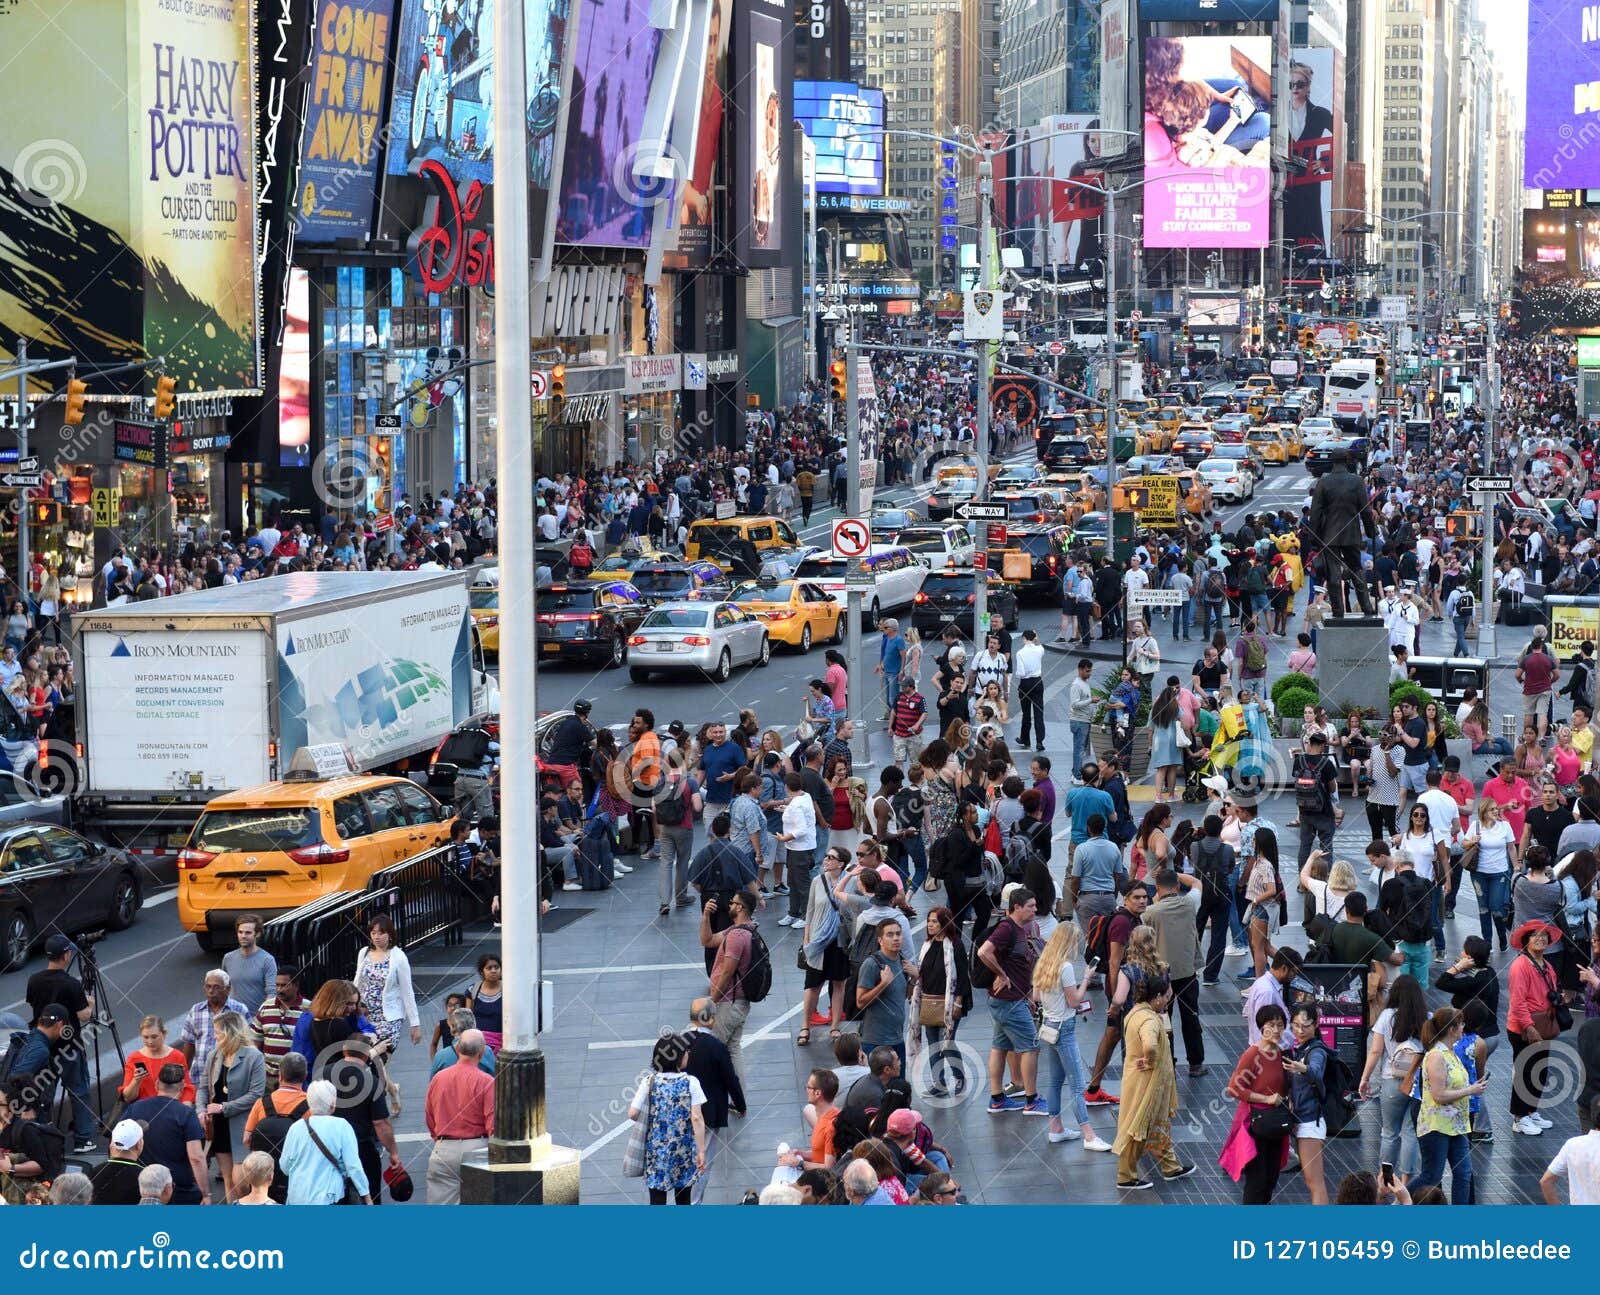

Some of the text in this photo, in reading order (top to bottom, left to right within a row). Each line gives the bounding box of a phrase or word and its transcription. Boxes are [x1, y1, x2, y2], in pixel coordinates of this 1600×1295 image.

[166, 0, 182, 12] BOLT
[185, 2, 193, 14] OF
[1582, 6, 1600, 42] N
[321, 3, 388, 62] COME
[153, 43, 239, 122] HARRY
[314, 54, 383, 115] FROM
[307, 109, 378, 165] AWAY
[149, 108, 248, 182] POTTER
[185, 182, 212, 196] AND THE
[1175, 193, 1238, 207] MILITARY
[161, 196, 237, 222] CURSED CHILD
[1175, 208, 1238, 221] FAMILIES
[1162, 221, 1251, 233] STAY CONNECTED
[172, 228, 227, 240] PARTS ONE AND TWO
[643, 360, 659, 377] POLO
[177, 395, 234, 420] LUGGAGE
[193, 437, 214, 450] SONY
[1142, 479, 1175, 488] REAL MEN
[1473, 480, 1507, 488] ONE WAY
[1151, 494, 1165, 502] STOP
[97, 489, 107, 521] ATM
[961, 506, 1001, 515] ONE WAY
[400, 604, 461, 629] INFORMATION MANAGED
[90, 622, 113, 630] 11684
[297, 629, 349, 654] IRON MOUNTAIN
[1554, 641, 1566, 650] The
[134, 644, 238, 657] IRON MOUNTAIN
[134, 674, 192, 682] INFORMATION
[135, 686, 223, 695] RECORDS MANAGEMENT
[136, 699, 225, 707] DOCUMENT CONVERSION
[136, 711, 200, 719] DIGITAL STORAGE
[1319, 1017, 1345, 1025] PLAYING
